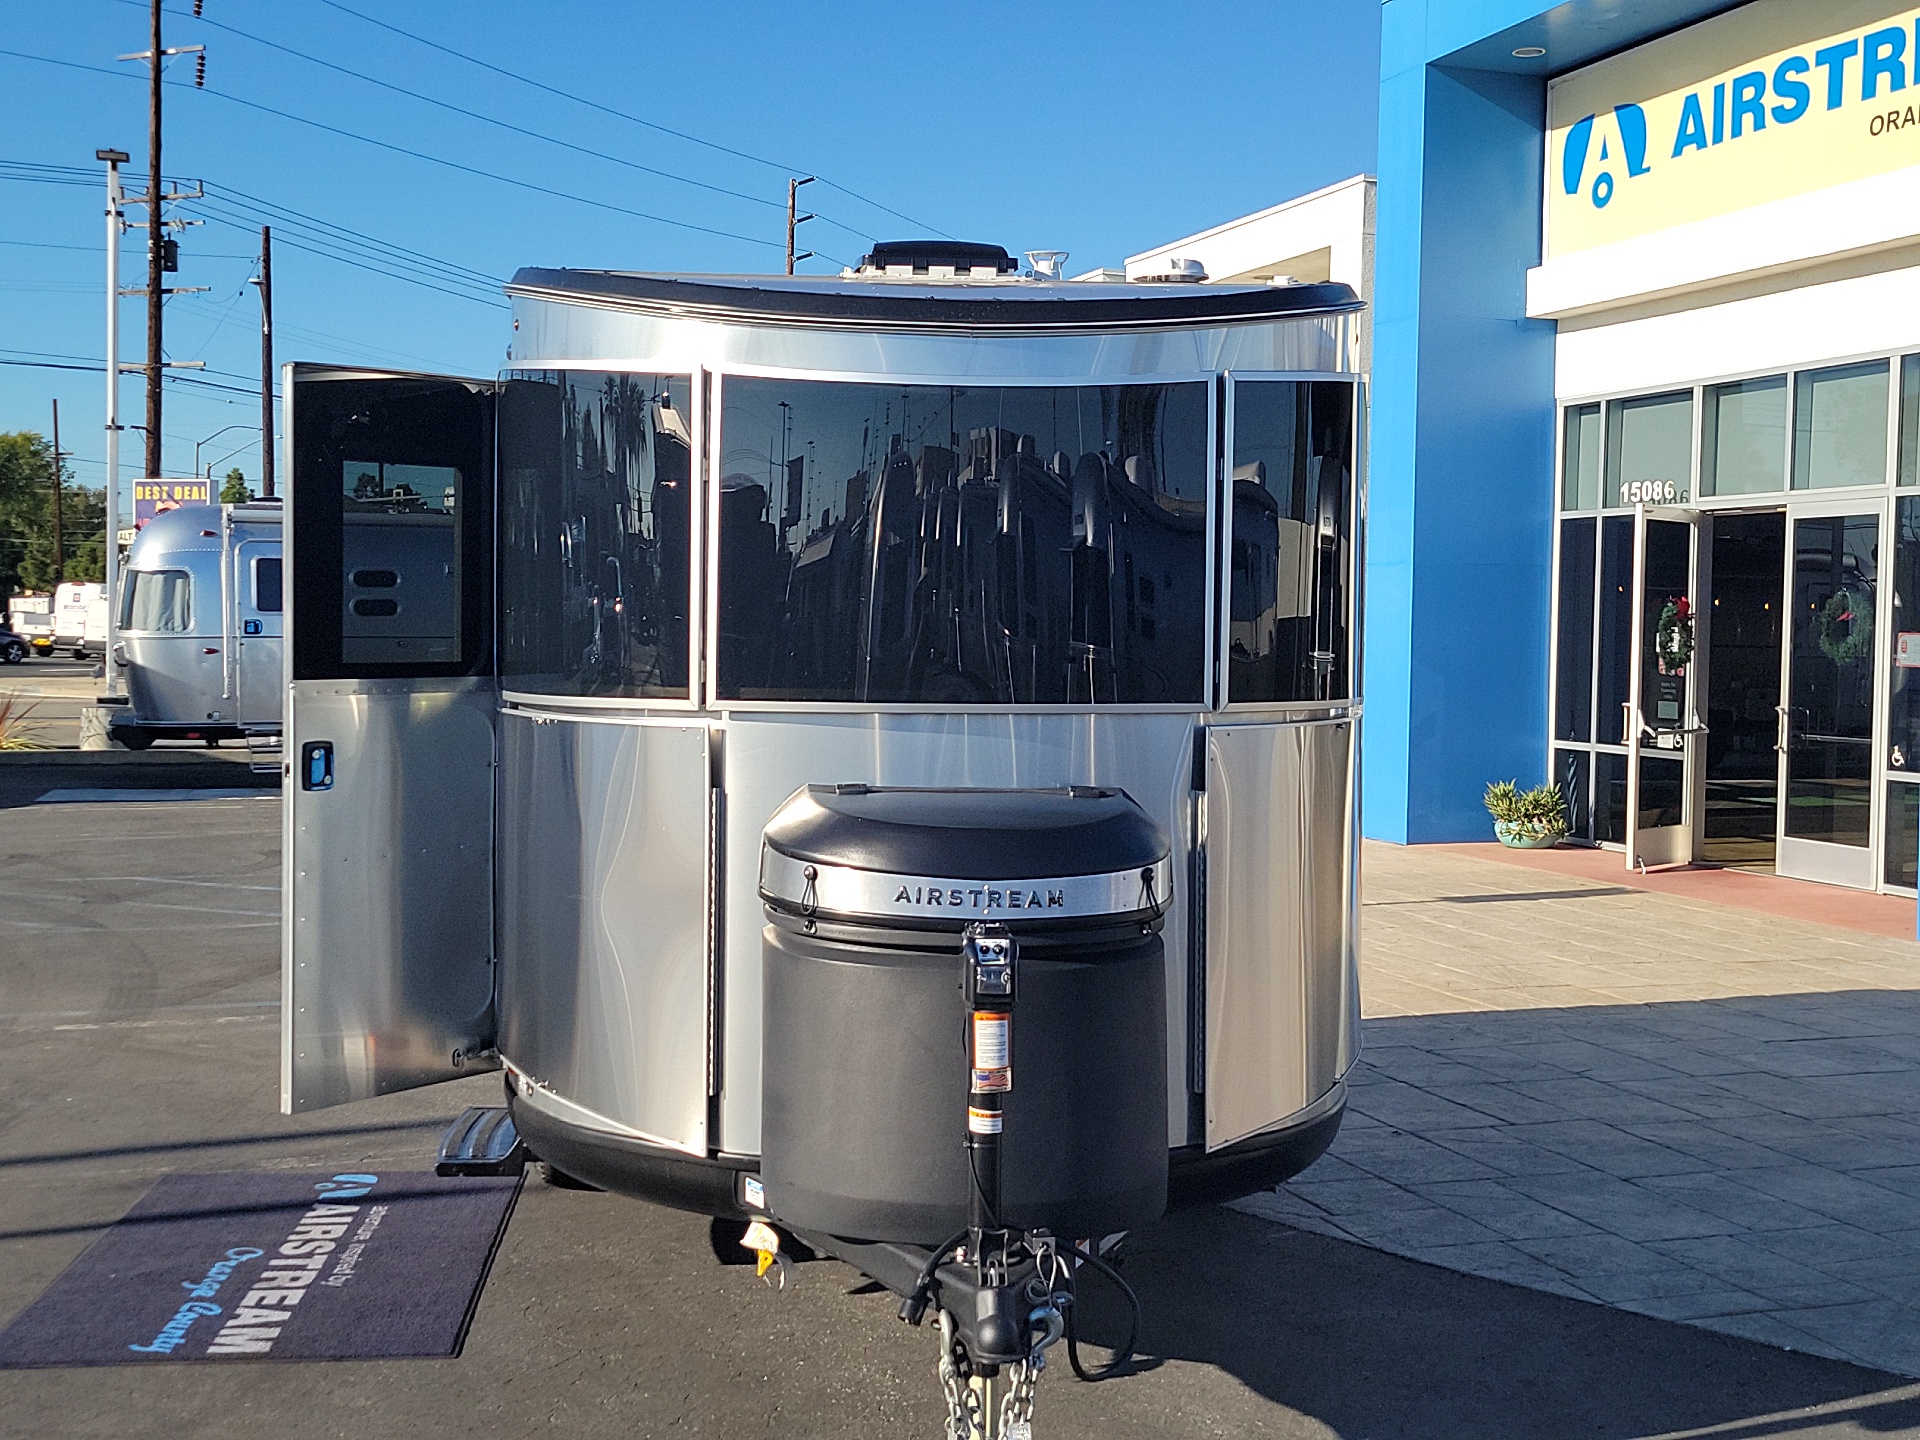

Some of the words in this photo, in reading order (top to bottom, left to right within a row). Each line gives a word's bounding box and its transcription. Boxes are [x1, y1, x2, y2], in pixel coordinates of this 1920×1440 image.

[1671, 17, 1920, 158] AIRSTR
[1869, 103, 1920, 136] ORA
[136, 486, 169, 500] BEST
[174, 486, 207, 500] DEAL
[1620, 480, 1675, 503] 15086
[894, 886, 1064, 909] AIRSTREAM
[206, 1203, 361, 1353] AIRSTREAM
[320, 1275, 353, 1287] by
